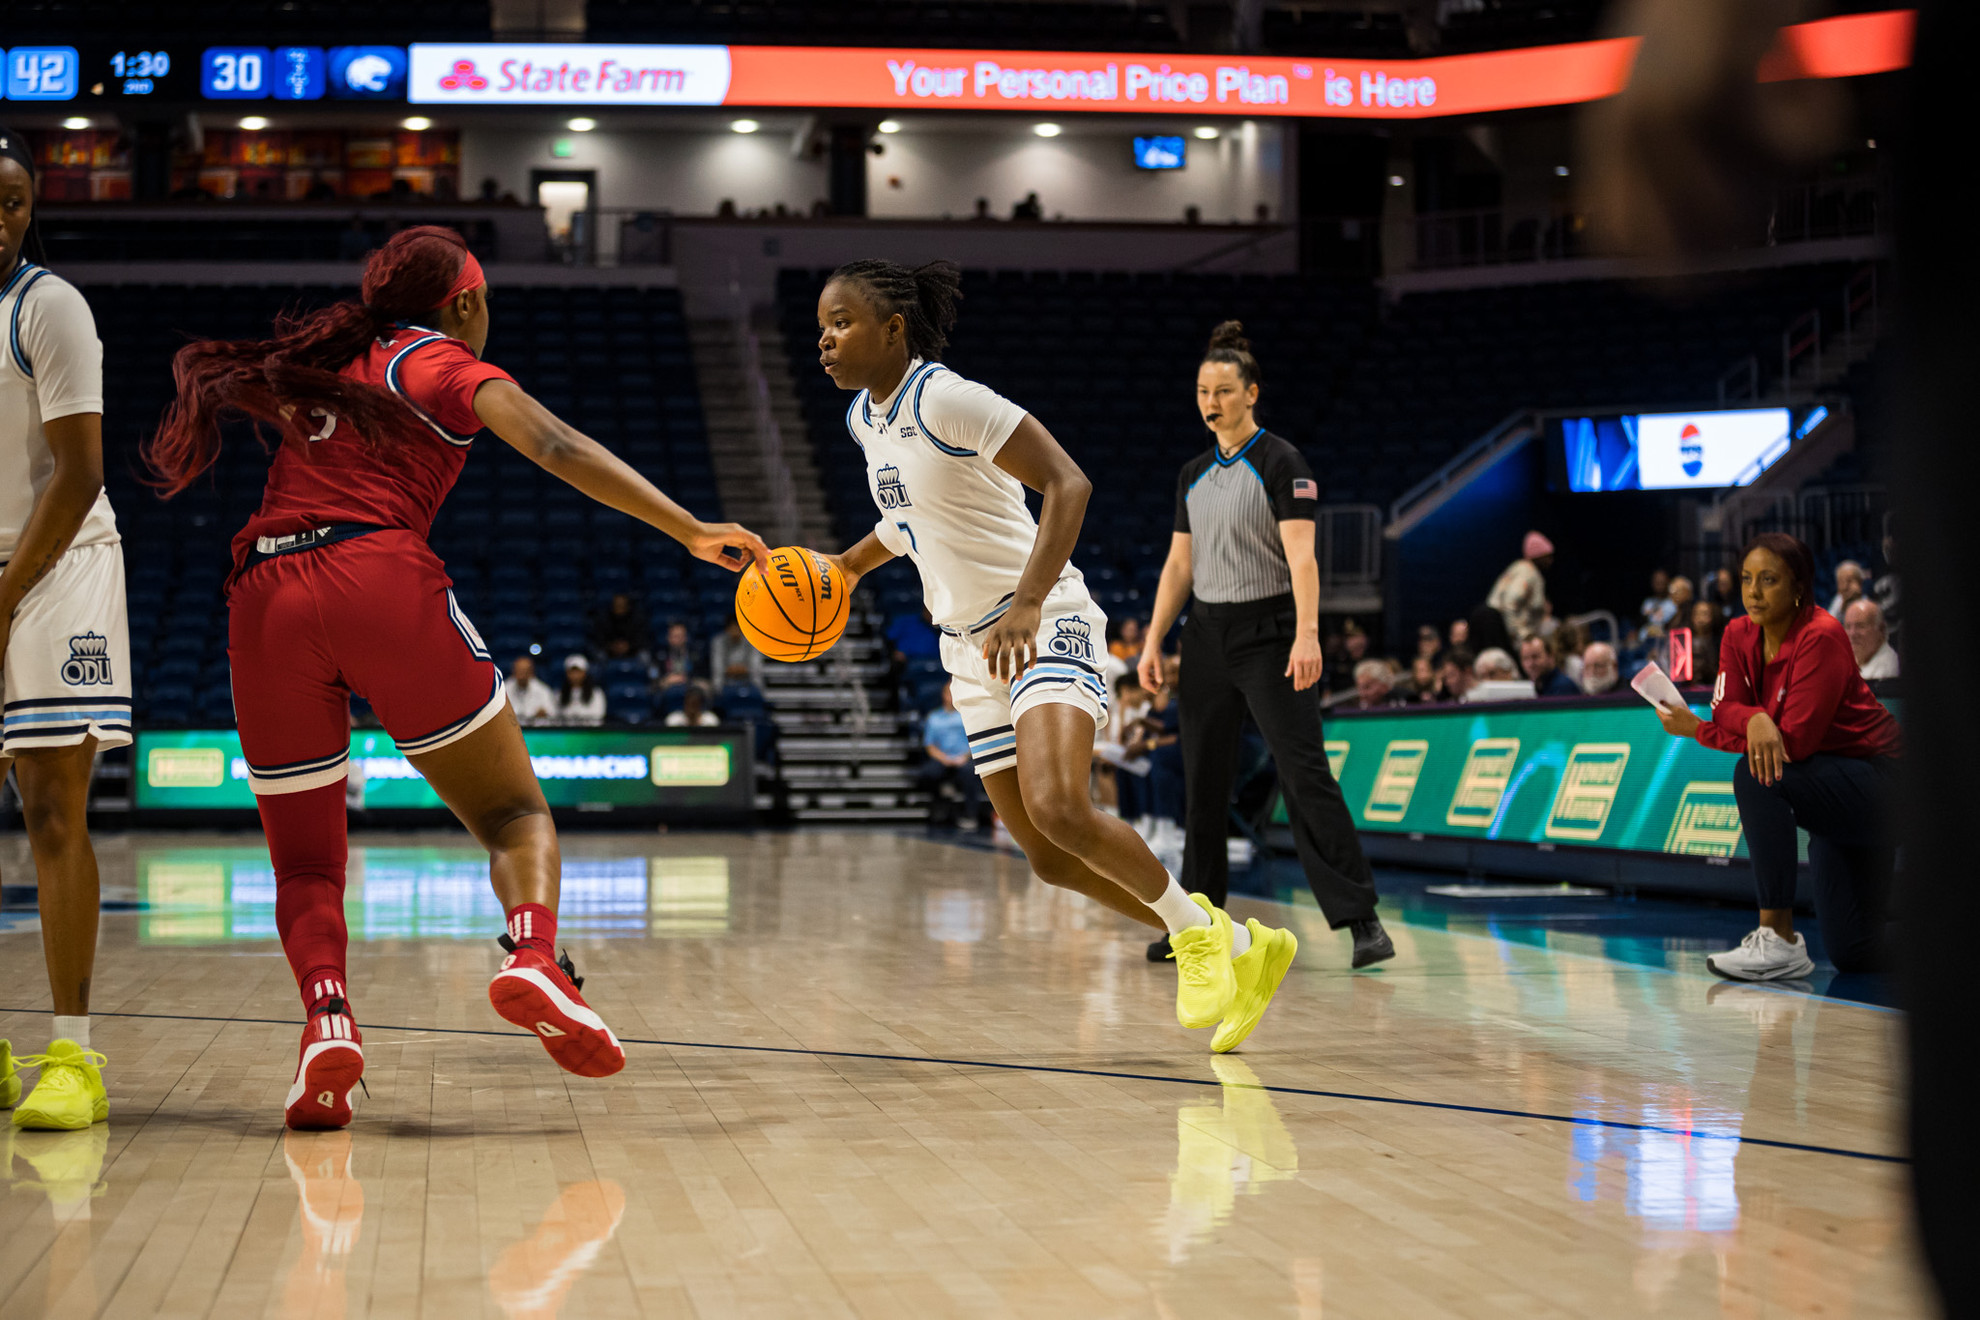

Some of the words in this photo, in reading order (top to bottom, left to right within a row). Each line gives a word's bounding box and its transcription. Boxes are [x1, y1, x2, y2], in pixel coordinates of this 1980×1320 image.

[16, 54, 65, 92] 42
[110, 51, 170, 77] 1:30
[211, 55, 262, 91] 30
[887, 60, 968, 97] Your
[974, 61, 1118, 99] Personal
[1126, 64, 1209, 101] Price
[1216, 67, 1288, 103] Plan
[1324, 69, 1353, 106] is
[1360, 72, 1437, 107] Here
[877, 482, 912, 509] ODU
[771, 554, 799, 588] EVO
[1048, 635, 1098, 664] ODU
[61, 658, 113, 686] ODU
